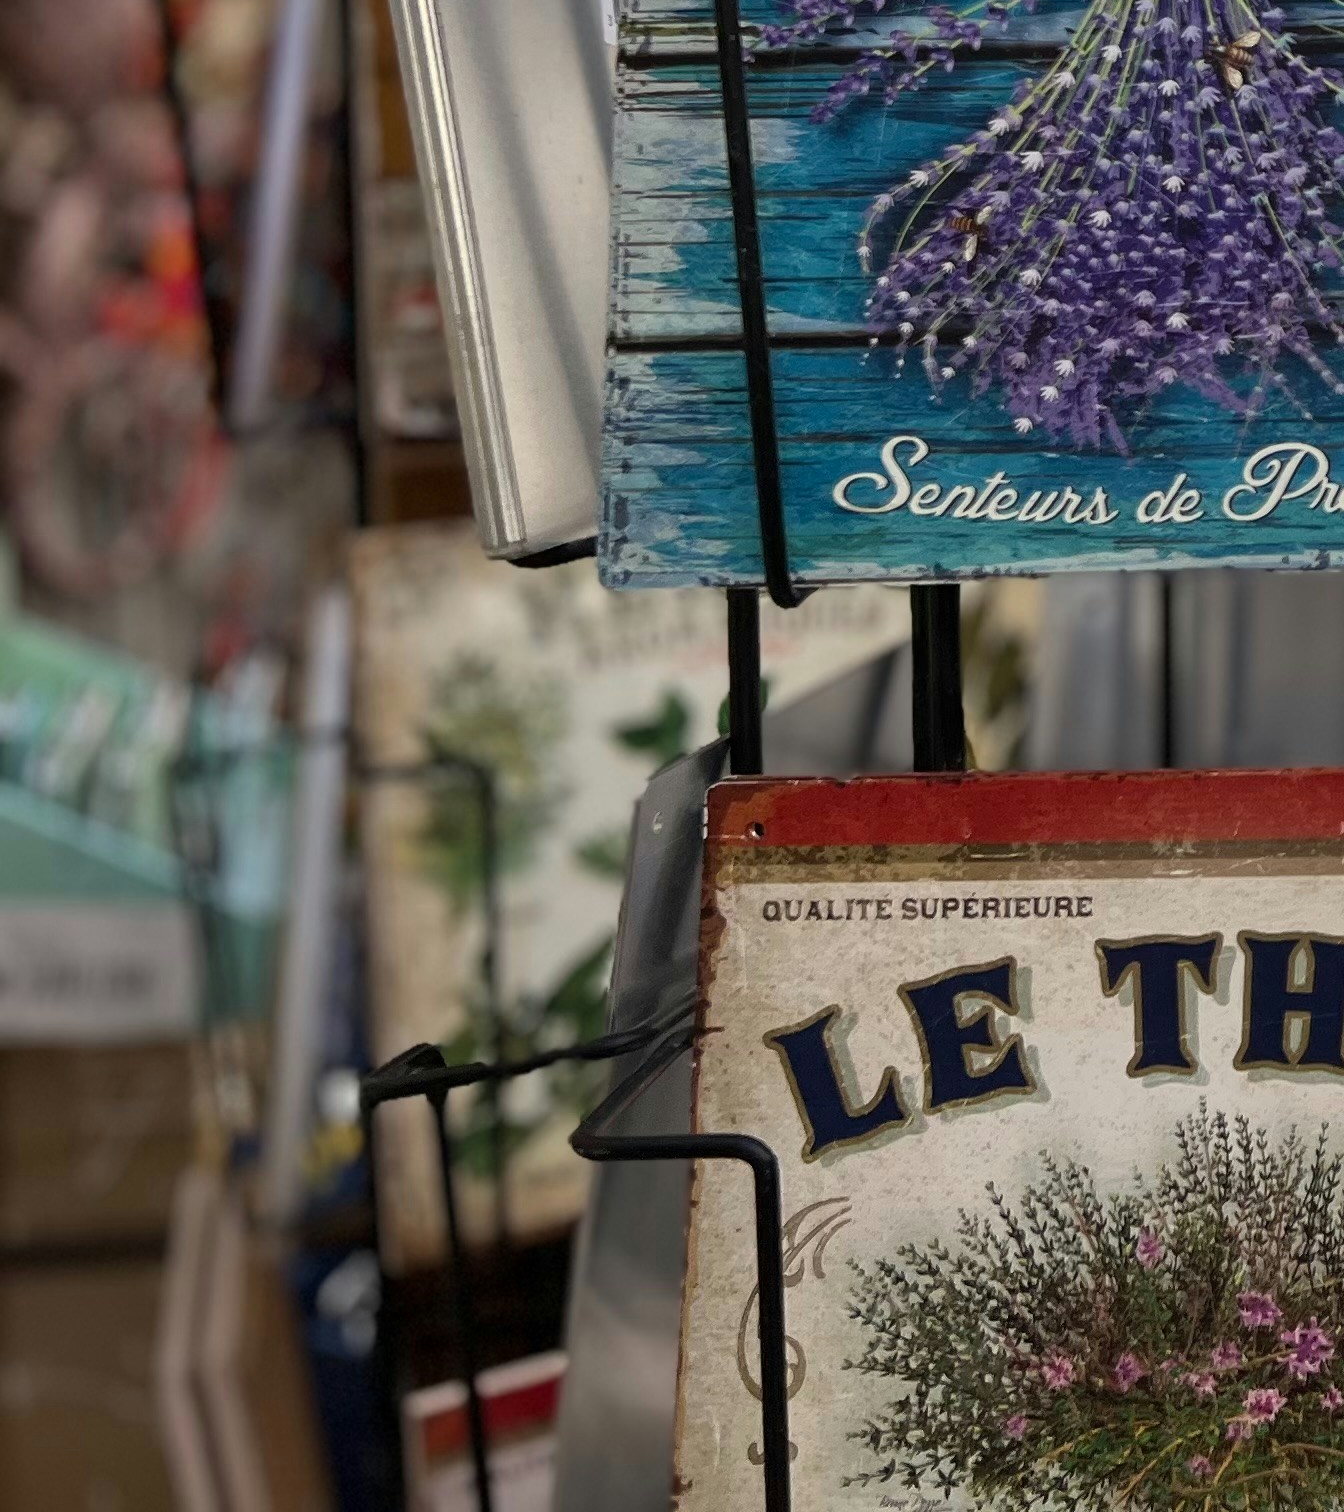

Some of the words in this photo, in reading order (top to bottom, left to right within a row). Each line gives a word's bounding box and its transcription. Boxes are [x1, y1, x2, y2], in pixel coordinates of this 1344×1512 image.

[834, 435, 1118, 525] Senteurs
[1136, 473, 1204, 524] de
[762, 893, 893, 922] QUALITÉ
[901, 892, 1094, 920] SUPÉRIEURE
[763, 956, 1035, 1164] LE
